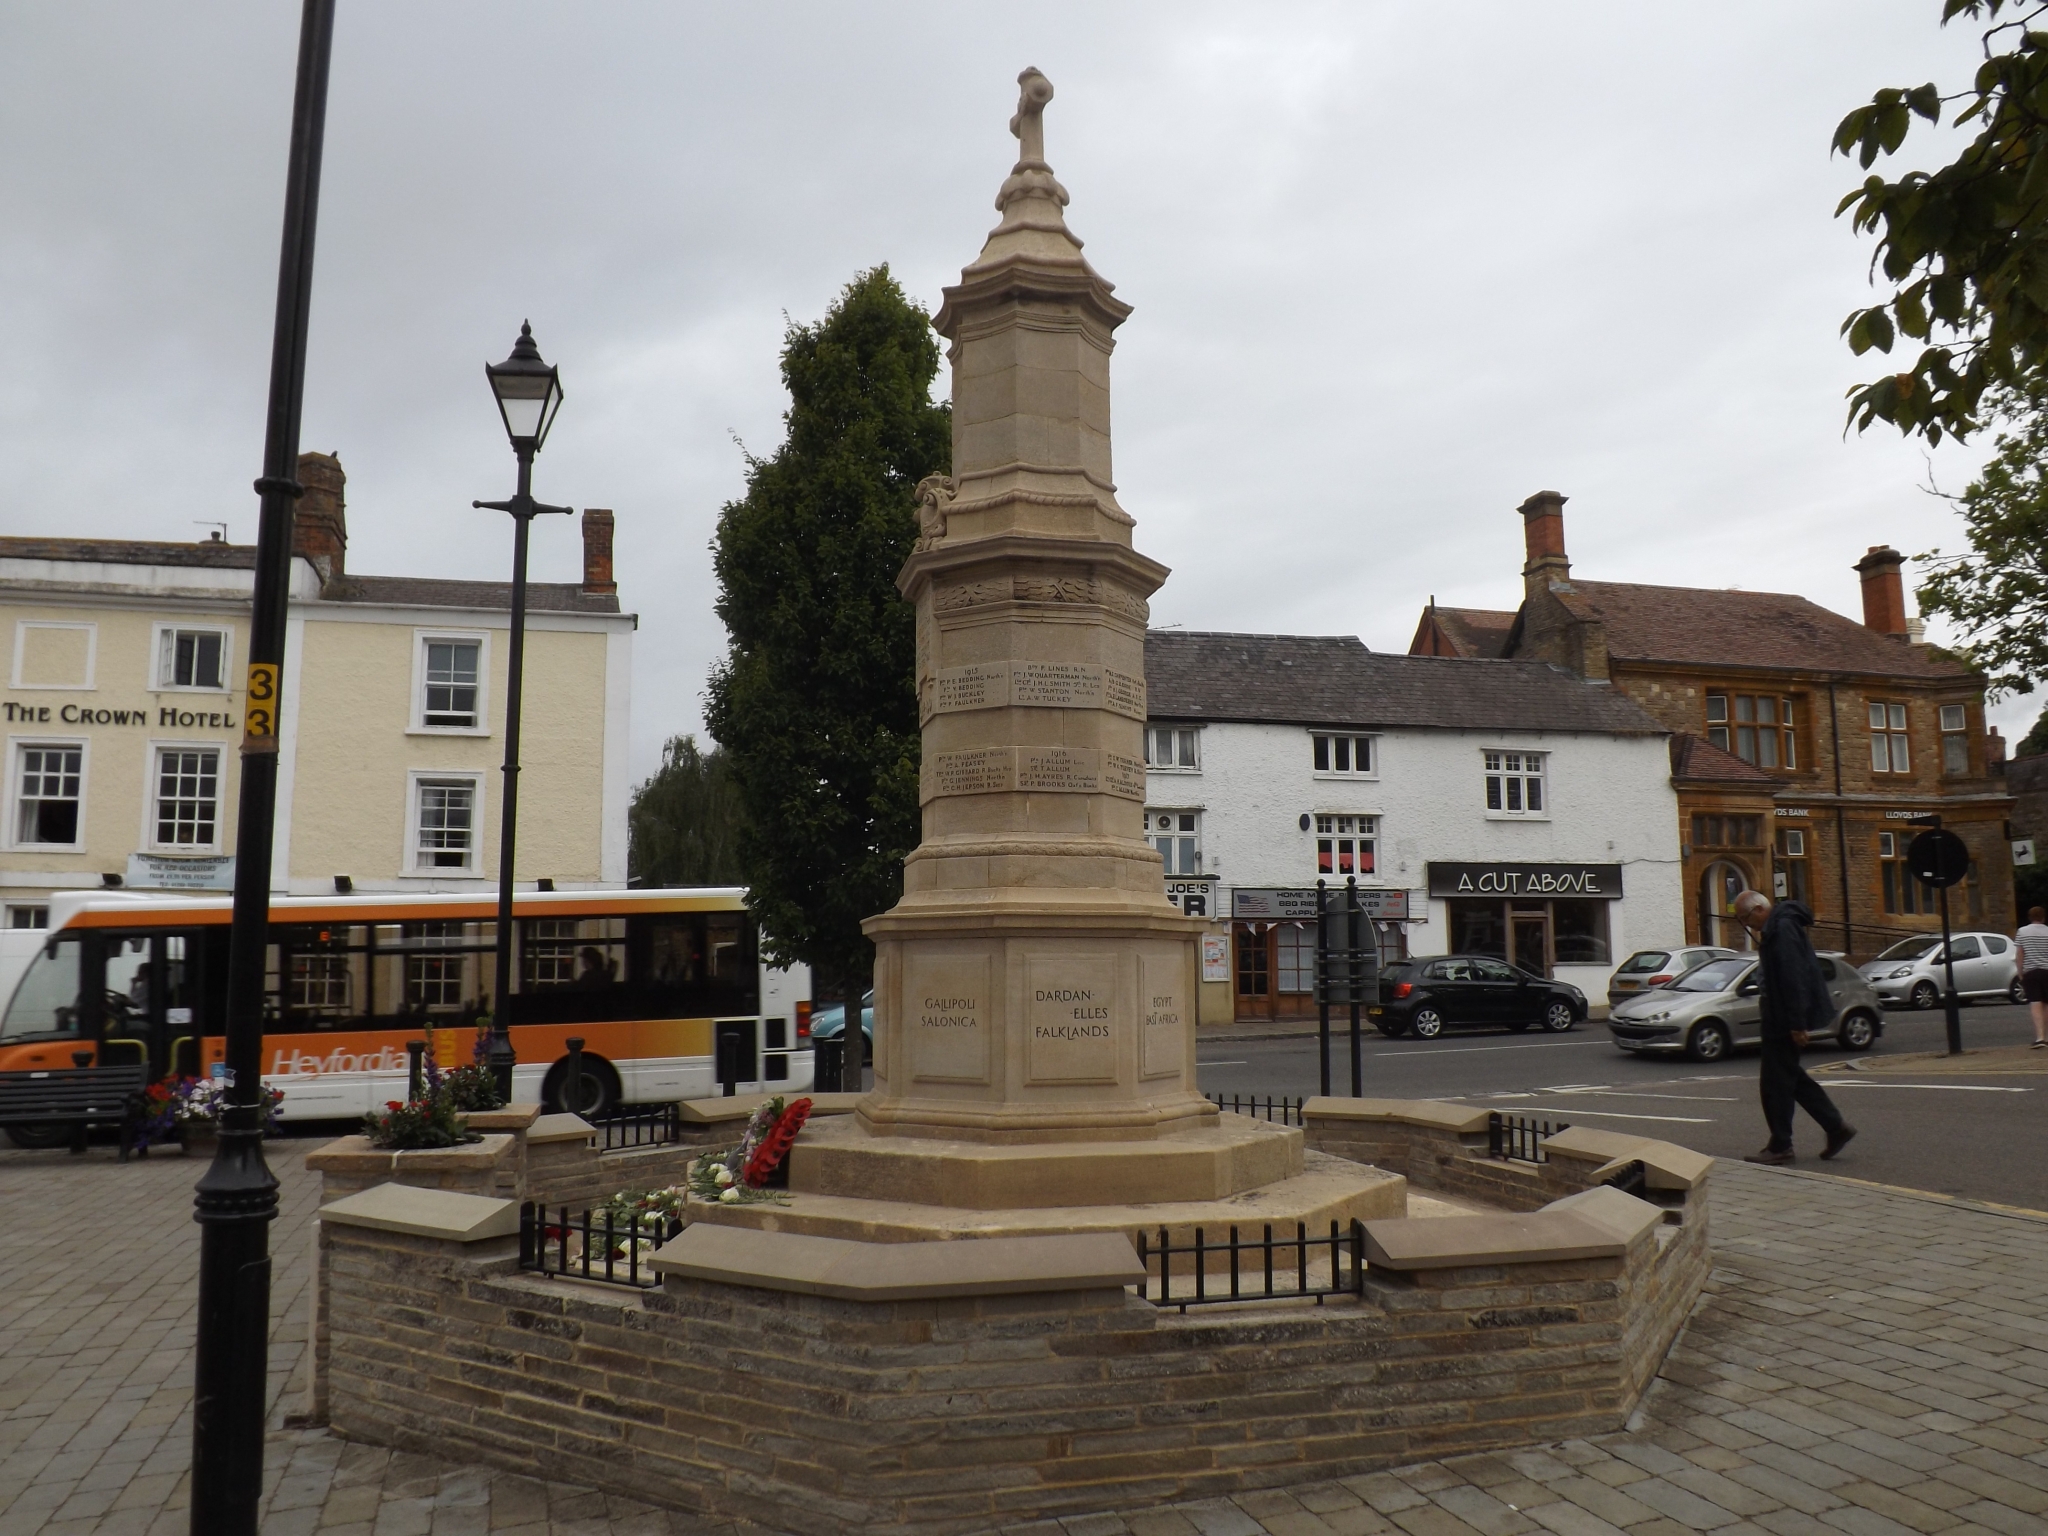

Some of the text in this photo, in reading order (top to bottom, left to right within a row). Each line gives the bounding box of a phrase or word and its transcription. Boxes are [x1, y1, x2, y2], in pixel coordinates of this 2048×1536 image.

[964, 667, 978, 676] 1915
[1034, 672, 1080, 680] QUARTERMAN
[958, 675, 985, 684] BEDDING
[249, 668, 274, 701] 3
[958, 690, 985, 699] BUCKLEY
[1038, 687, 1070, 695] STANTON
[955, 697, 985, 706] FAULKNER
[1042, 695, 1072, 703] TUCKEY
[61, 704, 147, 726] CROWN
[159, 707, 236, 728] HOTEL
[247, 708, 271, 737] 3
[955, 752, 987, 761] FAULKNER
[1051, 750, 1067, 758] 1916
[955, 775, 983, 784] JENNINGS
[962, 782, 985, 791] JEPSON
[1773, 808, 1810, 816] YDS BANK
[1886, 811, 1913, 819] LLOYDS
[1458, 870, 1601, 894] A CUT ABOVE
[1167, 883, 1210, 894] JOE'S
[925, 998, 975, 1012] GALLIPOLI
[1153, 997, 1172, 1008] EGYPT
[921, 1016, 977, 1027] SALONICA
[1158, 1014, 1179, 1025] AFRICA
[1036, 1026, 1109, 1040] FALKLANDS
[270, 1045, 414, 1075] Heyfordia
